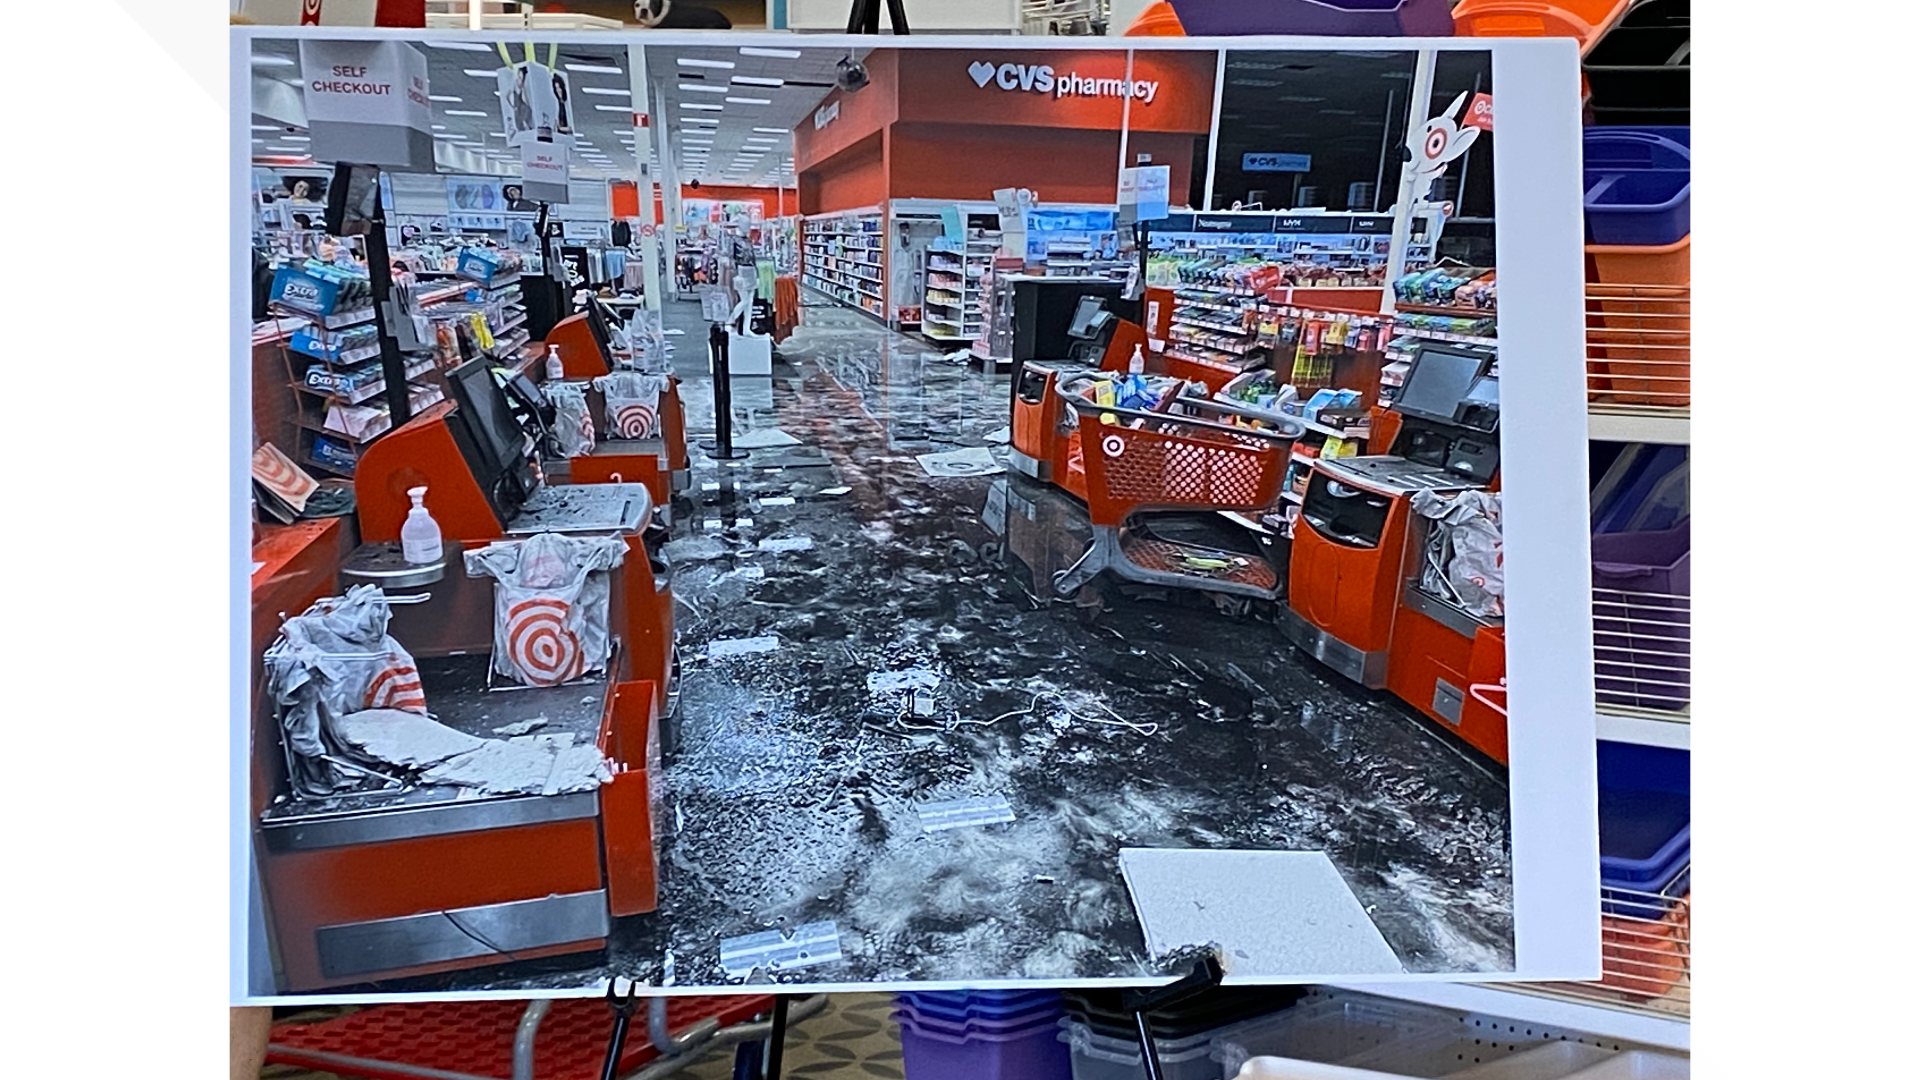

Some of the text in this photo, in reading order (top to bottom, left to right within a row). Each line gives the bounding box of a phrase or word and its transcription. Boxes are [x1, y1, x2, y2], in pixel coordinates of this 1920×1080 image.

[332, 65, 367, 78] SELF
[311, 80, 391, 95] CHECKOUT
[996, 63, 1159, 103] CVS pharmacy
